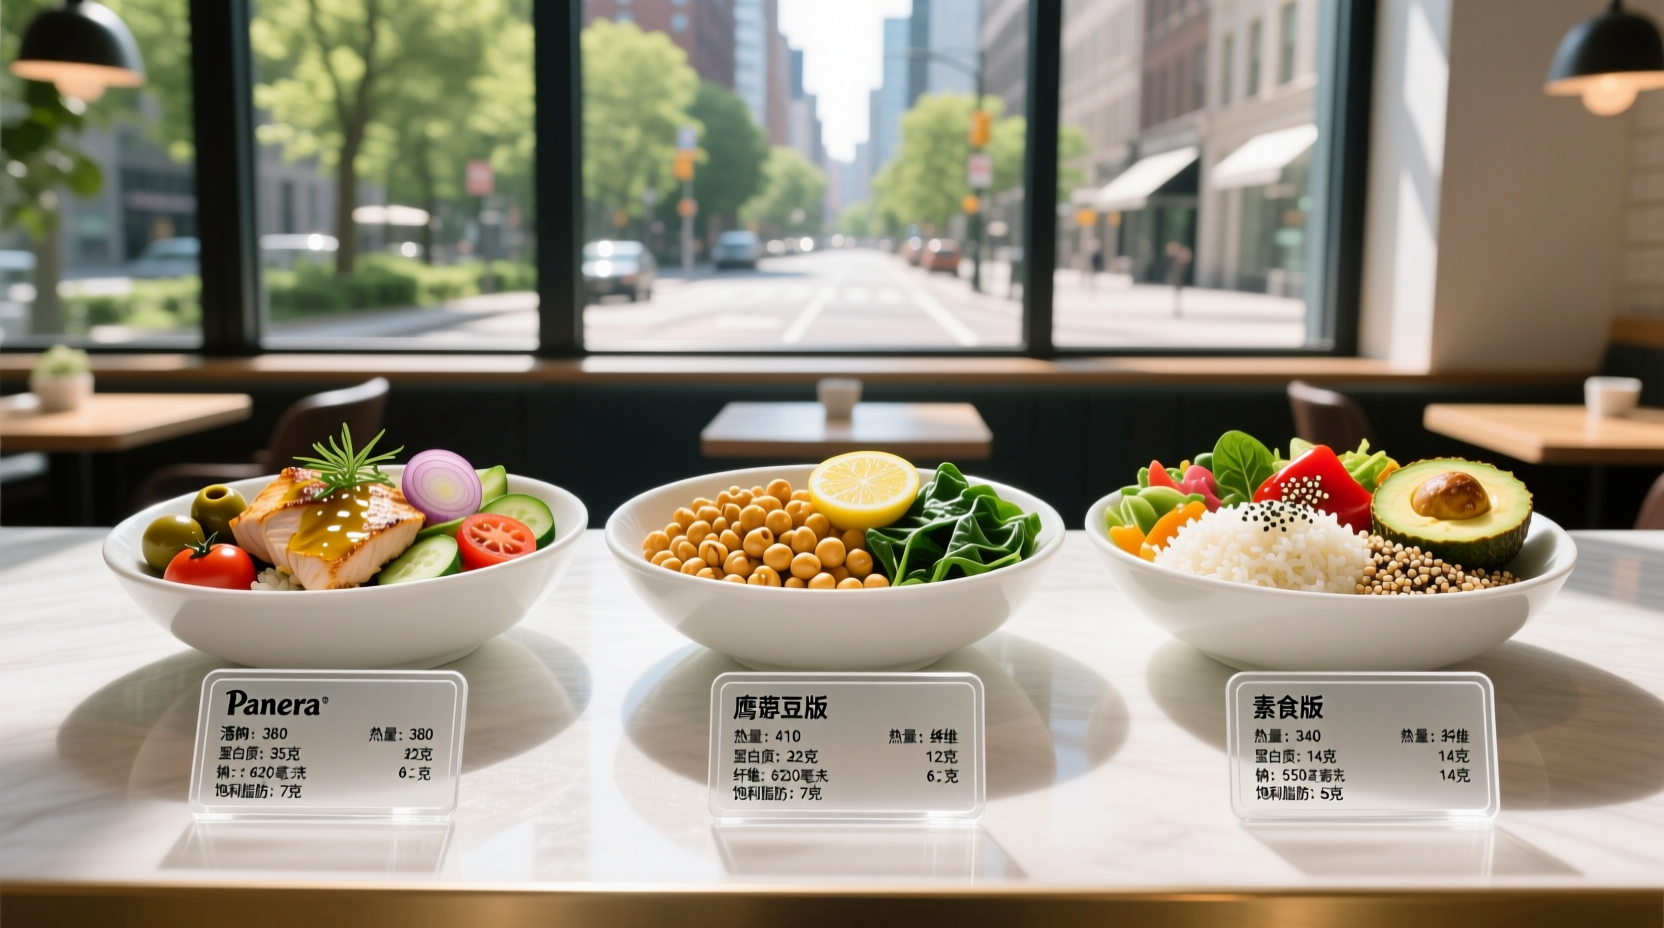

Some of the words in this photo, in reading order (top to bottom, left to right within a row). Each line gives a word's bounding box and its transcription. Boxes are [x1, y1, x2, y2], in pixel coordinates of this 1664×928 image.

[1253, 694, 1323, 719] 素食版
[927, 749, 958, 764] 12克
[1439, 748, 1470, 763] 14克
[1440, 768, 1470, 783] 14克
